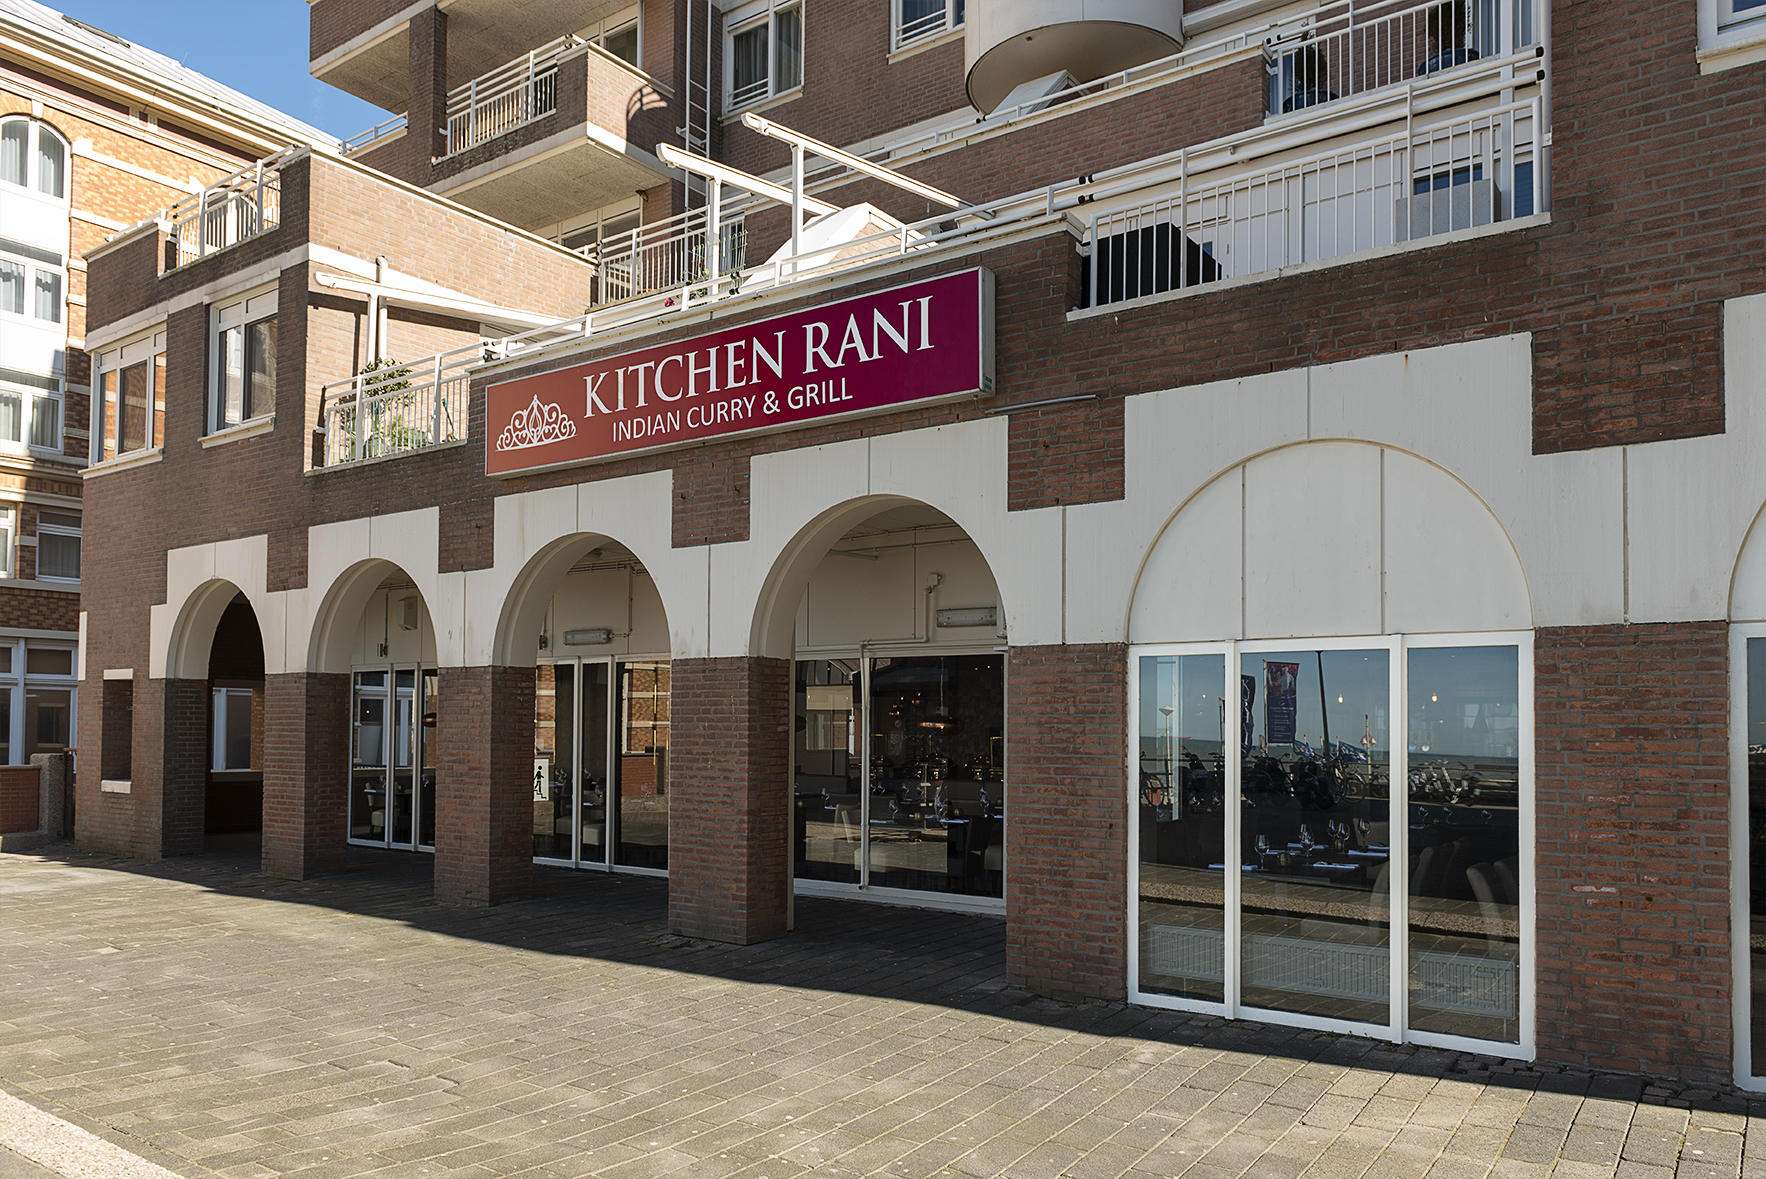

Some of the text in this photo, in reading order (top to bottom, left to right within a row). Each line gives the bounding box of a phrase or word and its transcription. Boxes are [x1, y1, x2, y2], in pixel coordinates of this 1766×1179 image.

[583, 295, 935, 419] KITCHEN RANI
[612, 377, 854, 443] INDIAN CURRY & GRILL
